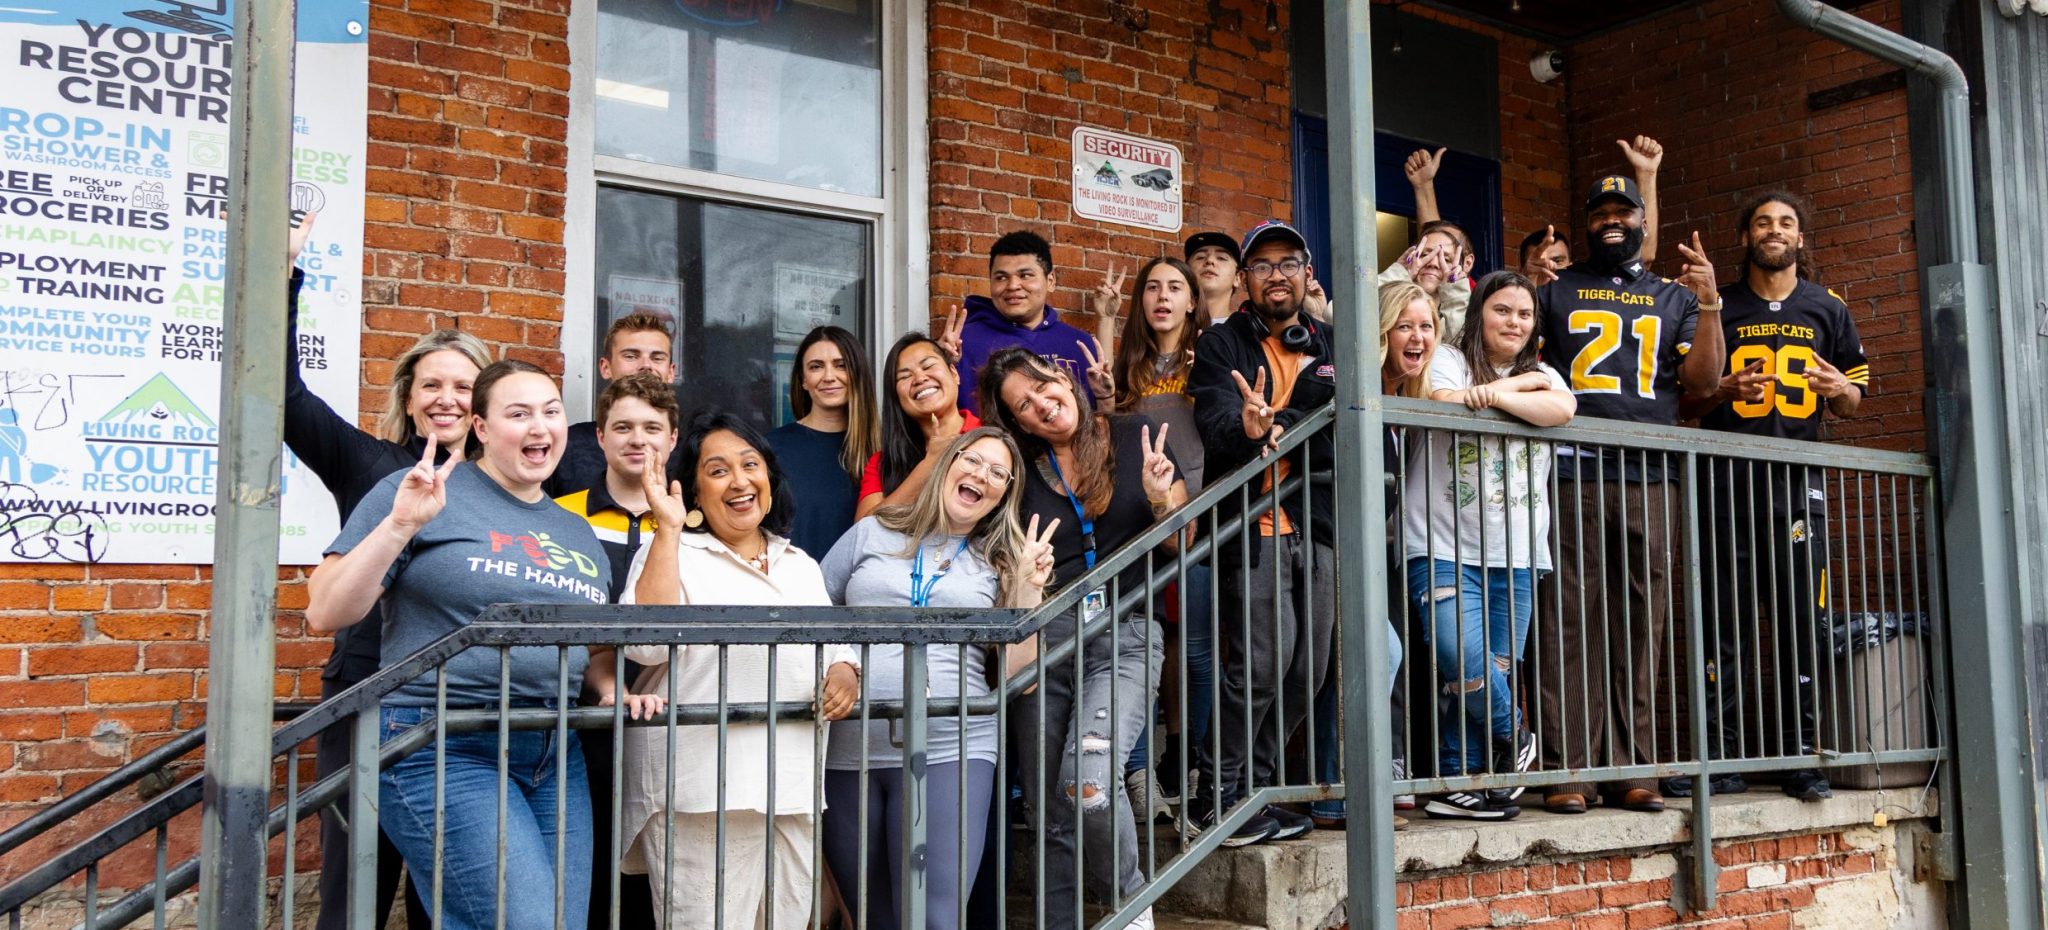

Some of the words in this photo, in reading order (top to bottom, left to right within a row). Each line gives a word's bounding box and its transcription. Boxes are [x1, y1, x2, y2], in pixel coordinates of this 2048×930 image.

[20, 39, 232, 96] RESOUR
[58, 76, 229, 124] CENTR
[0, 106, 171, 152] ROP-IN
[4, 134, 142, 165] SHOWER
[151, 153, 169, 168] &
[1085, 136, 1169, 166] SECURITY
[5, 151, 106, 171] WASHROOM
[112, 164, 172, 179] ACCESS
[296, 164, 348, 185] ESS
[0, 168, 53, 193] EE
[70, 176, 100, 186] PICK
[105, 180, 122, 188] UP
[86, 185, 105, 193] OR
[187, 172, 228, 196] FR
[1602, 177, 1626, 192] 21
[63, 190, 128, 204] DELIVERY
[1078, 187, 1091, 199] THE
[1091, 189, 1111, 202] LIVING
[1112, 193, 1128, 205] ROCK
[1129, 196, 1135, 206] IS
[1136, 197, 1167, 212] MONITORED
[1168, 204, 1176, 213] BY
[0, 195, 170, 231] OCERIES
[1099, 204, 1116, 216] VIDEO
[1117, 207, 1158, 223] SURVEILLANCE
[0, 224, 175, 255] HAPLAINCY
[328, 243, 342, 257] &
[0, 252, 166, 282] PLOYMENT
[16, 277, 164, 304] TRAINING
[173, 283, 224, 306] AR
[1577, 289, 1655, 306] TIGER-CATS
[0, 305, 85, 322] MPLETE
[92, 312, 151, 327] YOUR
[0, 320, 150, 344] MMUNITY
[1737, 323, 1814, 339] TIGER-CATS
[0, 338, 63, 352] RVICE
[71, 343, 145, 358] HOURS
[162, 347, 203, 360] FOR
[1568, 310, 1661, 400] 21
[82, 422, 161, 438] LIVING
[173, 425, 217, 441] ROC
[82, 473, 214, 495] RESOURCE
[128, 522, 198, 535] YOUTH
[467, 557, 518, 577] THE
[525, 565, 607, 605] HAMMER
